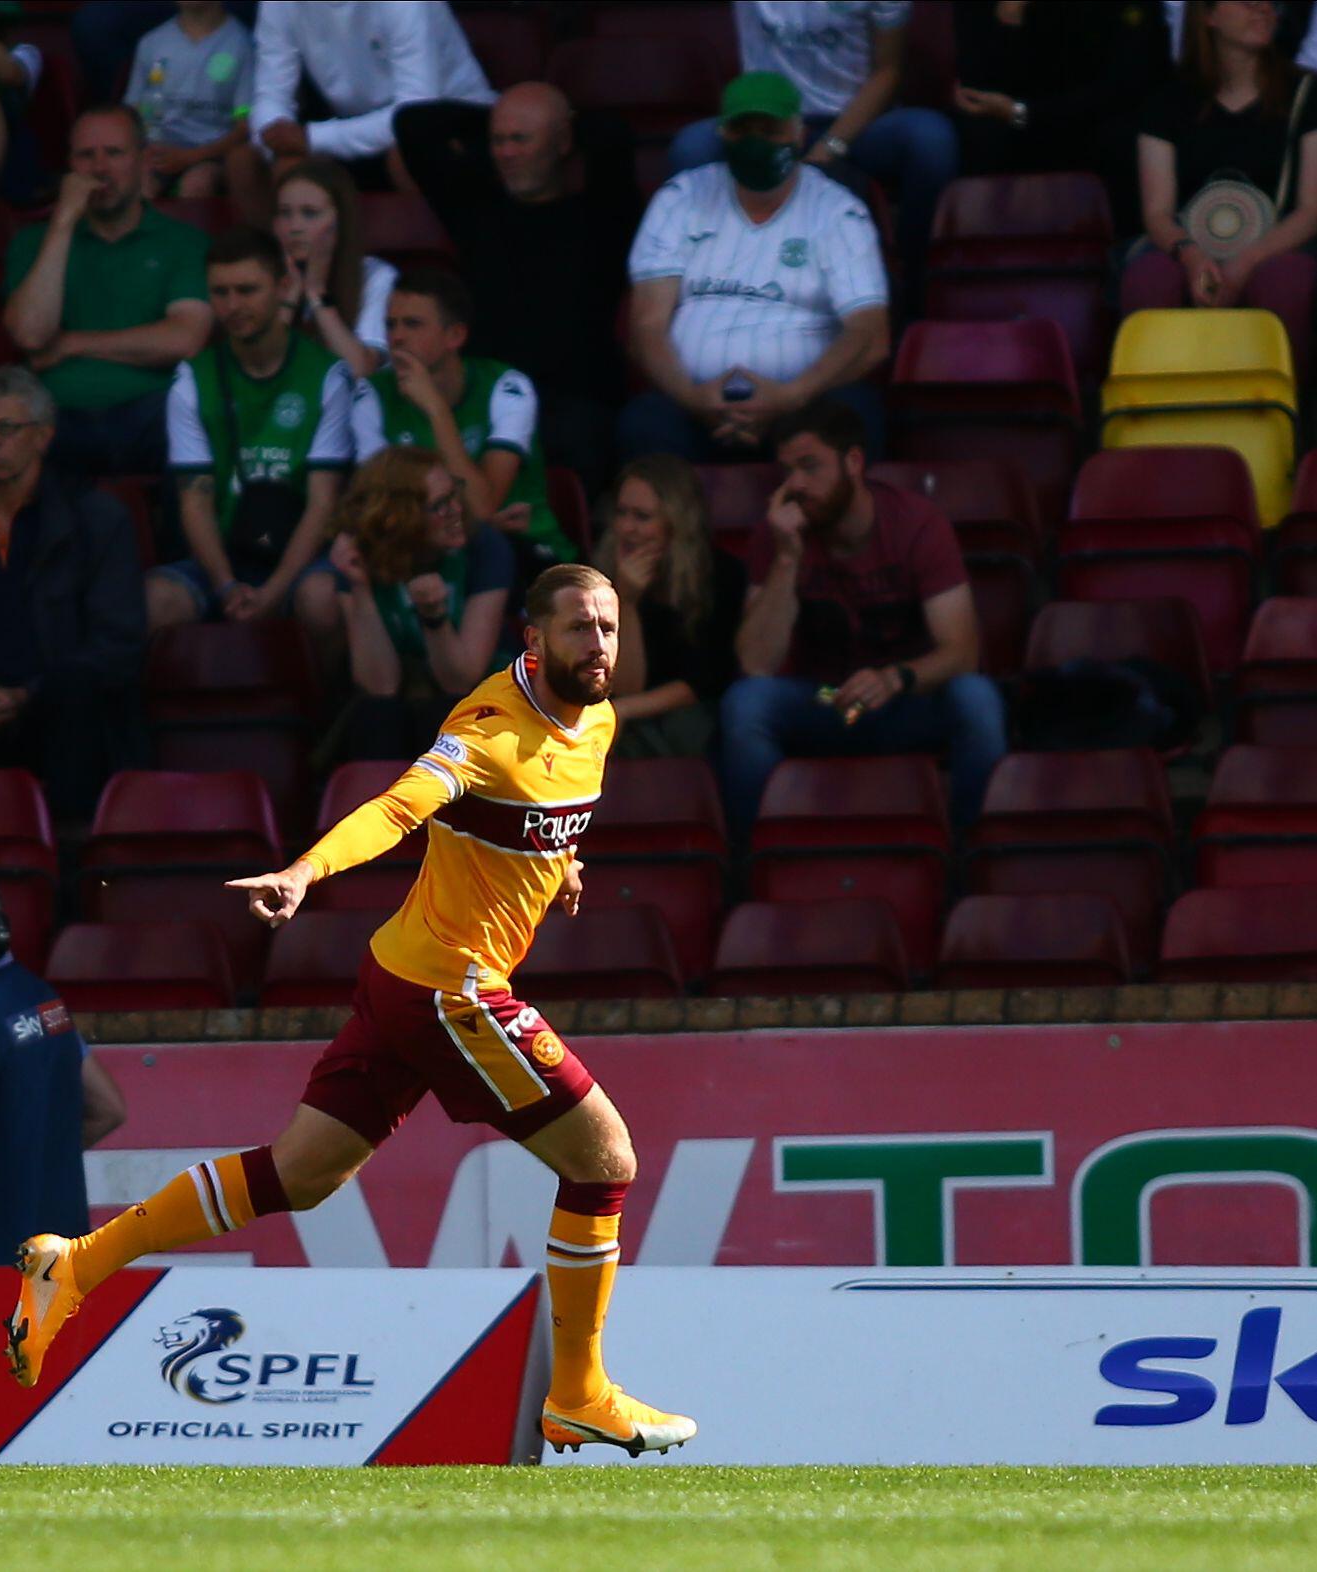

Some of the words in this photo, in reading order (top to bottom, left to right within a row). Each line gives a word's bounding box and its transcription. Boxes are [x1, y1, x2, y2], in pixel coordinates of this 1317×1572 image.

[214, 1353, 376, 1386] SPFL
[107, 1420, 253, 1439] OFFICIAL
[261, 1422, 365, 1439] SPIRIT
